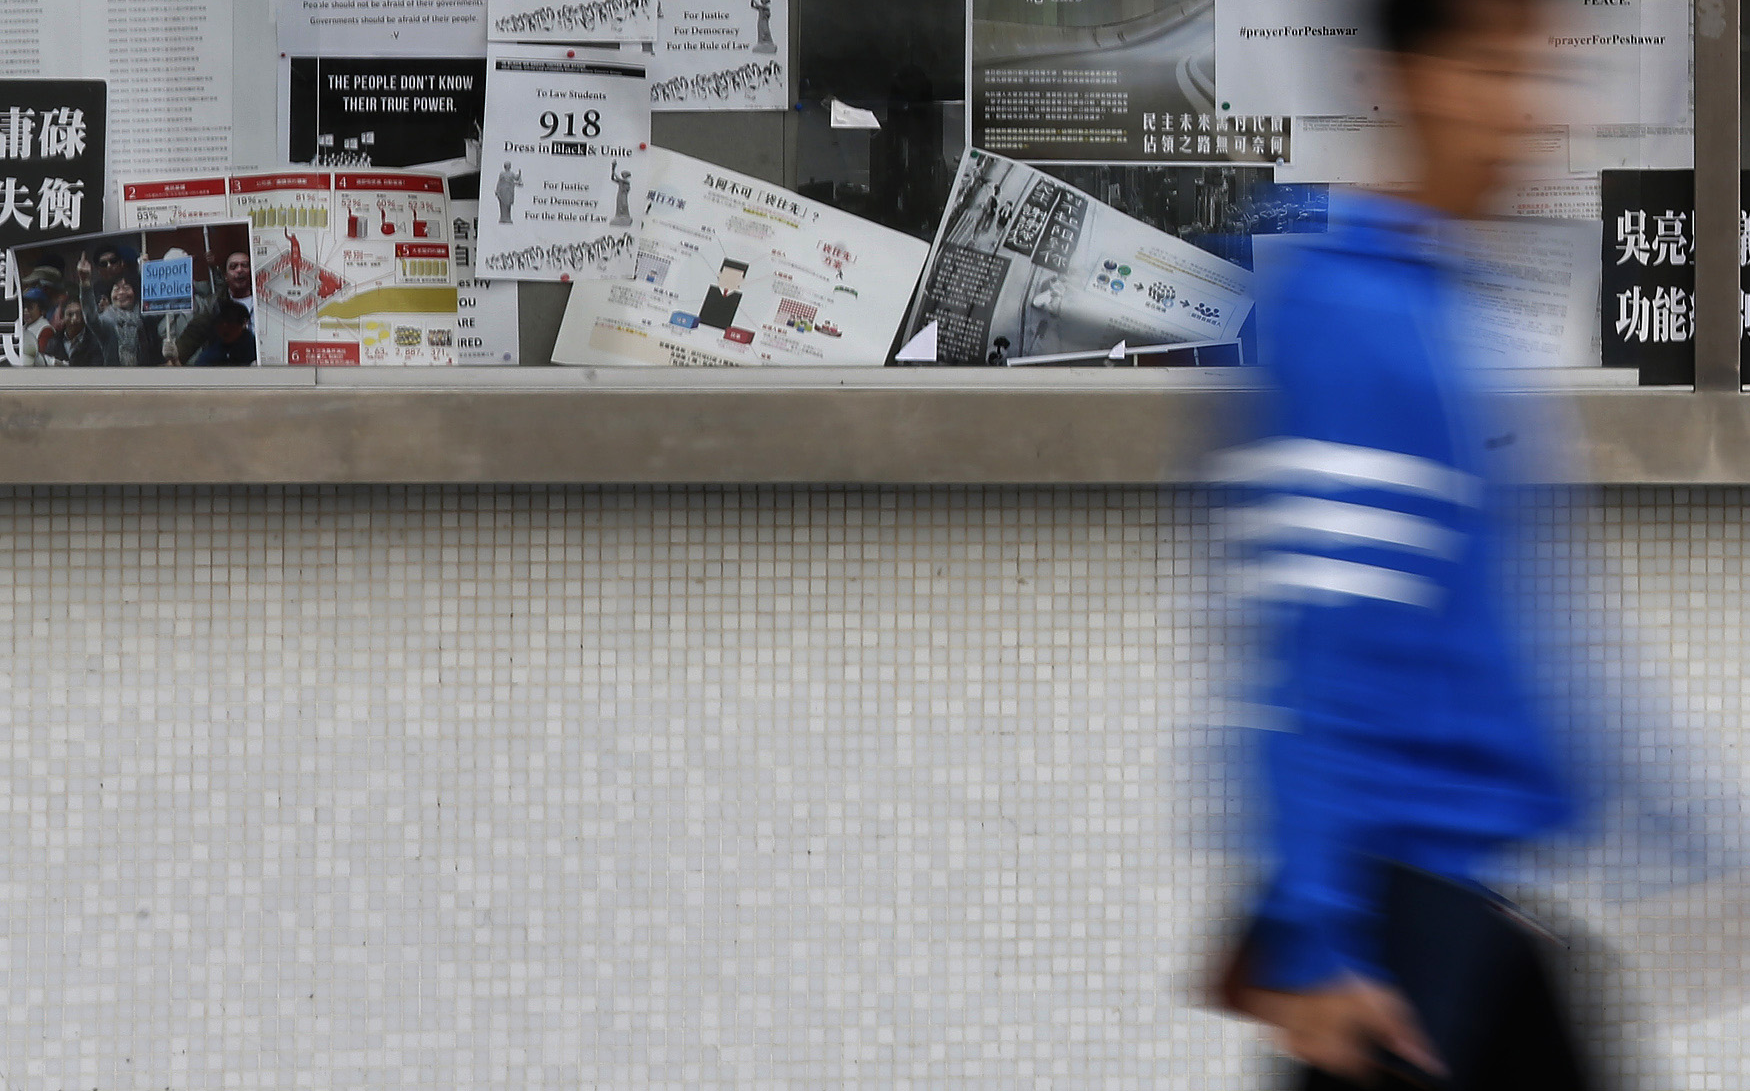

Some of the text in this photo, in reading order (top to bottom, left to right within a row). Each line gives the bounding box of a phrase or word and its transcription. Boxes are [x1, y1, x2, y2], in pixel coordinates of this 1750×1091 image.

[331, 0, 355, 8] should
[357, 0, 369, 8] not
[371, 0, 380, 8] be
[382, 0, 404, 8] afraid
[406, 0, 415, 8] of
[416, 0, 434, 7] their
[310, 16, 359, 25] Governments
[361, 16, 385, 24] should
[387, 16, 395, 24] be
[397, 15, 420, 24] afraid
[422, 15, 430, 24] of
[432, 14, 449, 23] their
[692, 26, 740, 37] Democracy
[1239, 25, 1358, 38] #prayerForPeshawar
[1548, 33, 1666, 47] #prayerForPeshawar
[327, 74, 474, 91] THE PEOPLE DON'T KNOW
[569, 90, 607, 101] Students
[343, 96, 457, 113] THEIR TRUE POWER.
[539, 109, 601, 139] 918
[504, 141, 632, 157] Dress in Black & Unite
[0, 177, 85, 232] 失衡
[551, 197, 599, 208] Democracy
[146, 262, 188, 282] Support
[143, 281, 192, 297] HK Police
